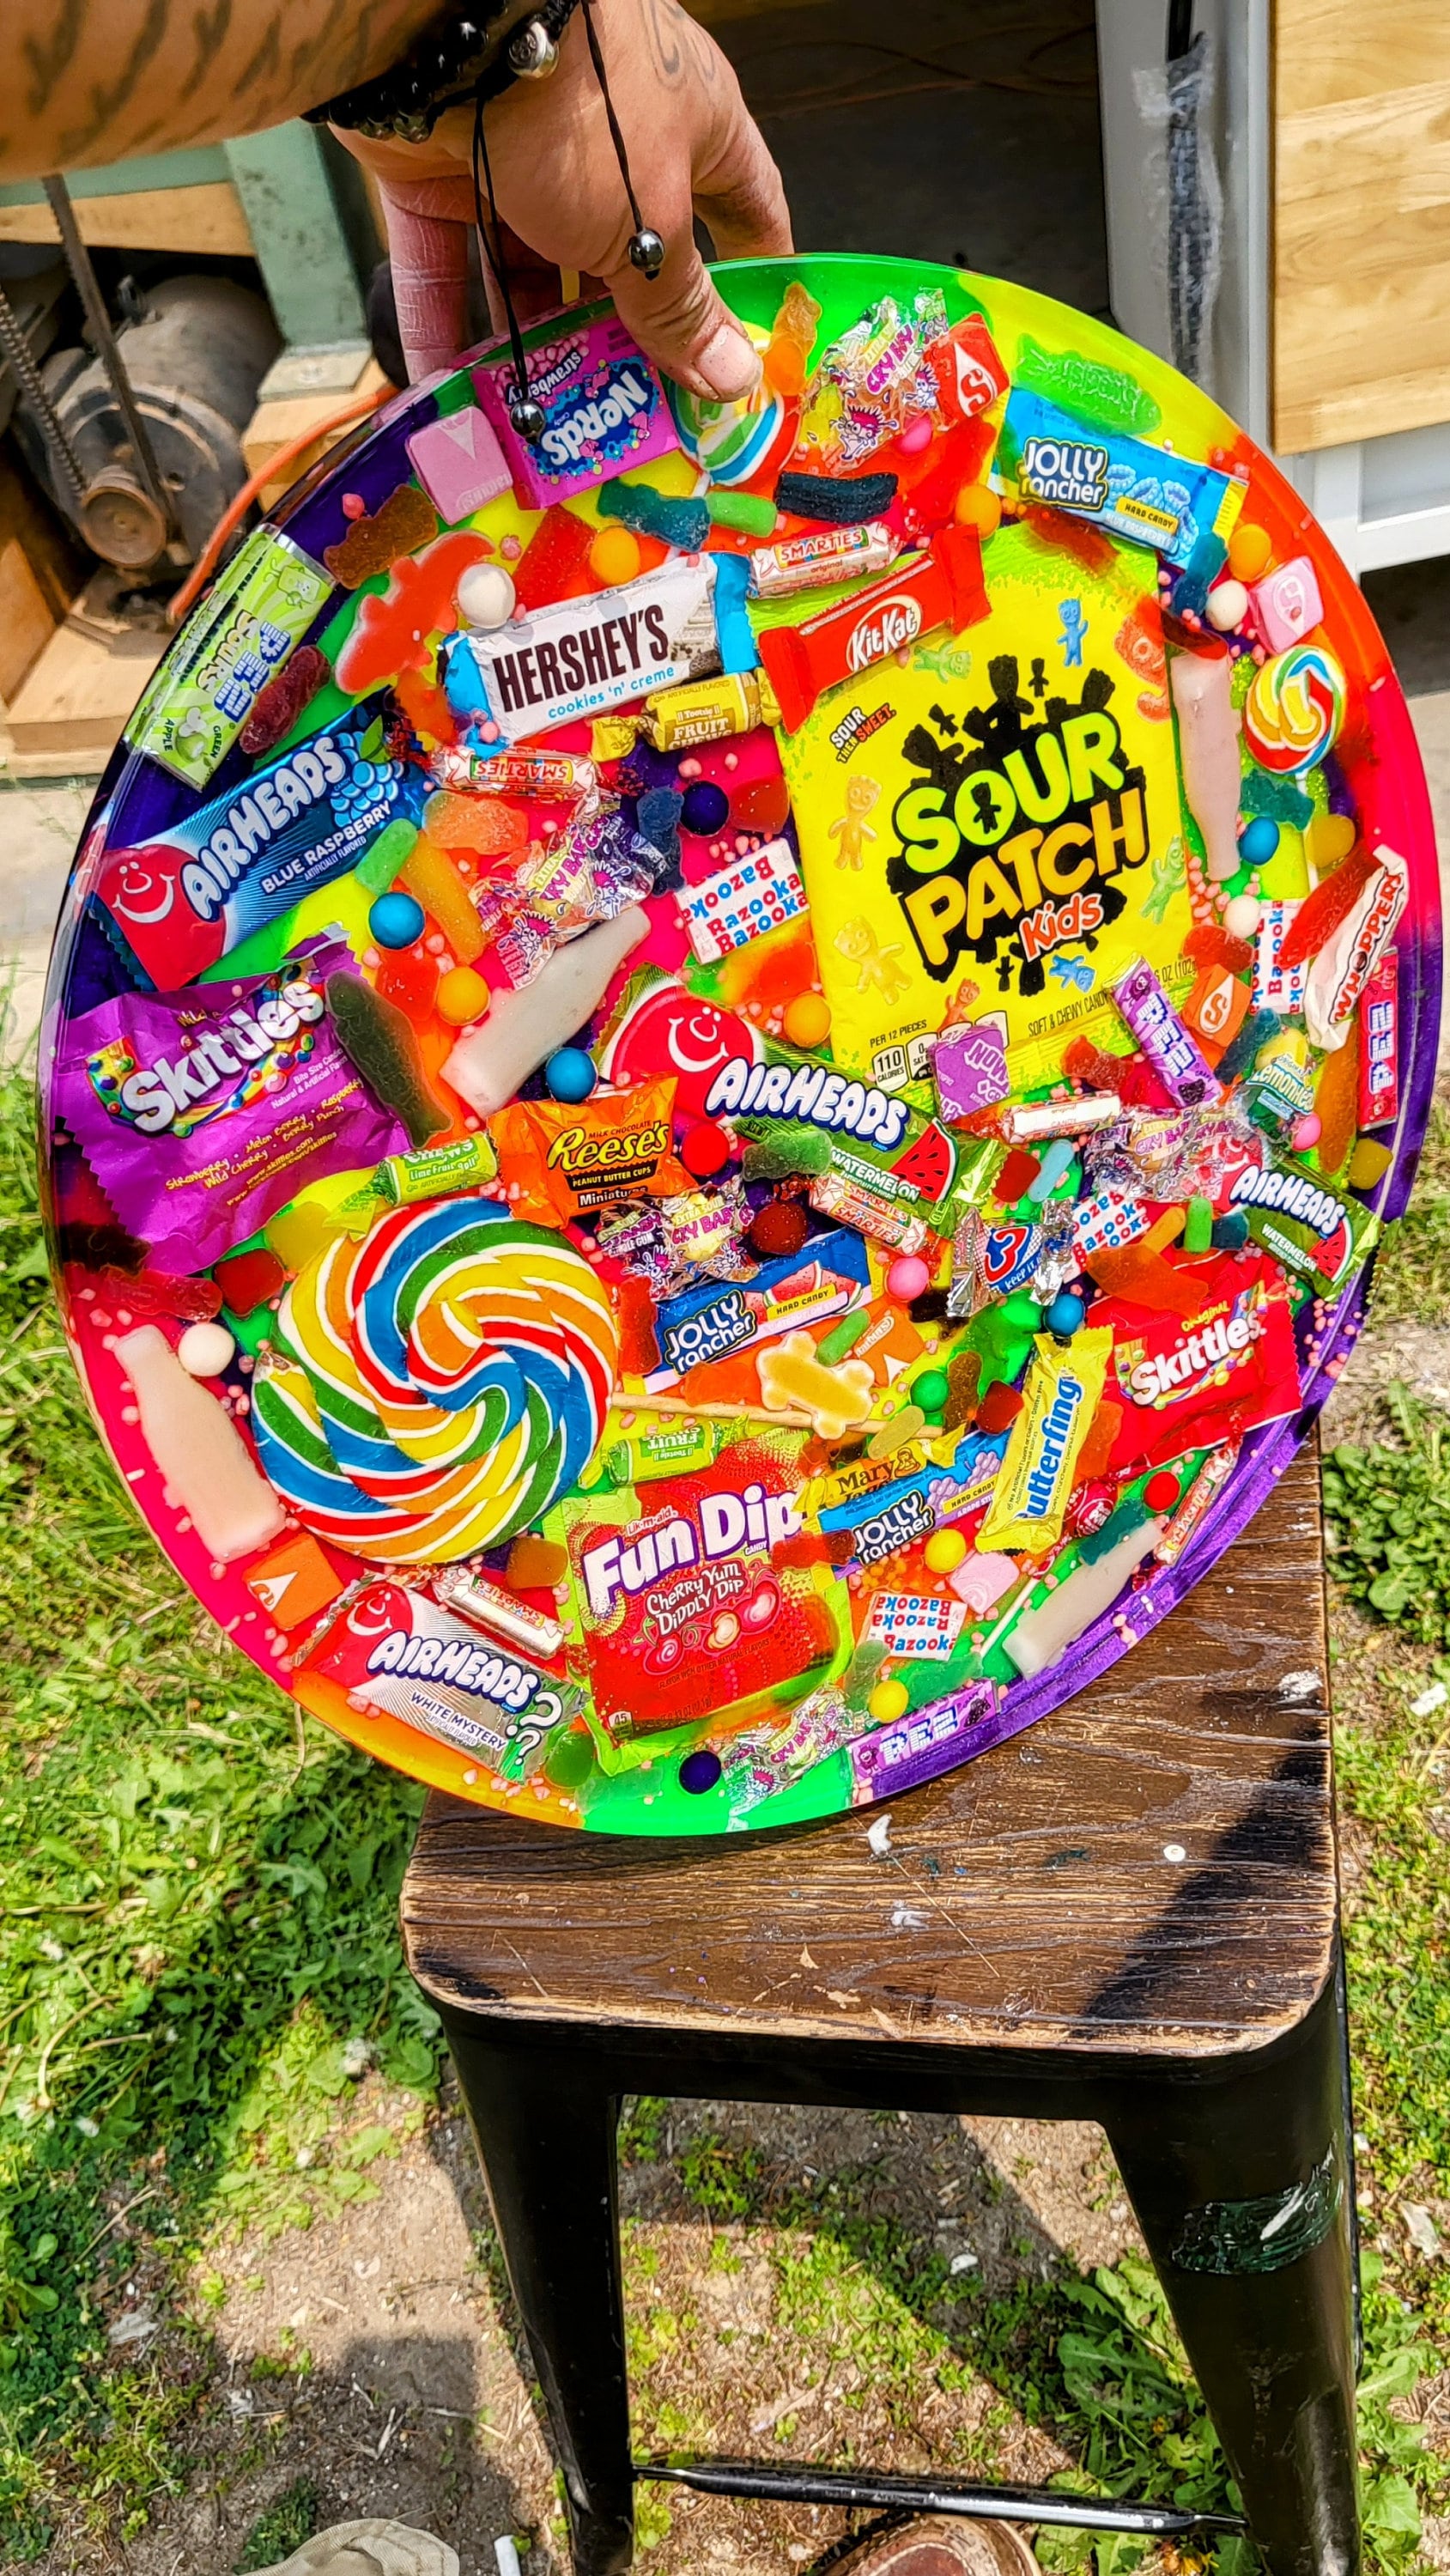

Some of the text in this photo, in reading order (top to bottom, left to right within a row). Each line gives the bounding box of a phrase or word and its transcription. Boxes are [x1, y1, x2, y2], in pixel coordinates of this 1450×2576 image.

[866, 351, 895, 394] CRY
[1026, 441, 1104, 483] JOLLY
[1021, 476, 1104, 505] rancher
[1124, 502, 1174, 529] HARD CANDY
[780, 529, 862, 560] SMARTIES
[810, 561, 843, 573] original
[197, 609, 258, 693] SOURS
[492, 605, 669, 713] HERSHEY'S
[215, 621, 291, 724] PEZ
[548, 694, 605, 720] cookies
[630, 666, 675, 691] creme
[673, 718, 729, 740] FRUIT
[684, 708, 713, 718] Tootsie
[830, 707, 866, 750] SOUR
[836, 702, 897, 763] THEN SWEET.
[163, 720, 175, 752] APPLE
[210, 726, 221, 759] GREEN
[476, 760, 568, 780] SMARTIES
[895, 712, 1126, 874] SOUR
[181, 737, 347, 920] AIRHEADS
[261, 800, 391, 894] BLUE RASPBERRY
[304, 835, 367, 882] ARTIFICIALLY FLAVORED
[906, 788, 1147, 966] PATCH
[683, 855, 774, 926] Bazooka
[716, 891, 809, 957] Bazooka
[1019, 893, 1105, 962] Kids
[1162, 969, 1173, 983] OZ
[870, 1019, 927, 1048] PER 12 PIECES
[1028, 1017, 1048, 1037] SOFT
[1049, 1017, 1056, 1030] &
[1057, 1005, 1083, 1024] CHEWY
[1136, 992, 1197, 1077] PEZ
[122, 981, 324, 1133] Skittles
[877, 1050, 901, 1072] 110
[1369, 1002, 1395, 1095] PEZ
[270, 1091, 298, 1110] Natural
[305, 1066, 331, 1090] Artificial
[293, 1063, 323, 1084] Bite Size
[877, 1066, 905, 1083] CALORIES
[707, 1059, 907, 1145] AIRHEADS
[547, 1121, 670, 1171] Reese's
[589, 1120, 652, 1139] MILK CHOCOLATE
[1136, 1132, 1163, 1156] CRY
[410, 1169, 432, 1181] Lime
[432, 1163, 455, 1175] Fruit
[573, 1166, 651, 1187] PEANUT BUTTER CUPS
[831, 1151, 921, 1203] WATERMELON
[849, 1184, 907, 1221] SMARTIES
[1230, 1165, 1346, 1234] AIRHEADS
[671, 1222, 699, 1244] CRY
[701, 1206, 735, 1234] BAB
[836, 1206, 900, 1243] SMARTIES
[984, 1227, 1029, 1284] 3
[1262, 1223, 1318, 1273] WATERMELON
[776, 1290, 828, 1315] HARD CANDY
[668, 1293, 740, 1358] JOLLY
[676, 1315, 753, 1374] rancher
[1132, 1309, 1261, 1406] Skittles
[646, 1431, 698, 1450] FRUIT
[659, 1449, 686, 1459] Tootsie
[838, 1461, 895, 1495] Mary
[951, 1481, 995, 1509] HARD CANDY
[854, 1494, 919, 1554] JOLLY
[862, 1511, 930, 1564] rancher
[585, 1519, 695, 1616] Fun
[699, 1485, 801, 1559] Dip
[744, 1542, 767, 1556] CANDY
[702, 1563, 742, 1585] Yum
[715, 1578, 744, 1599] Dip
[477, 1580, 540, 1620] SMARTIES
[876, 1596, 952, 1616] Bazooka
[871, 1614, 949, 1631] Bazooka
[368, 1632, 541, 1706] AIRHEADS
[658, 1675, 681, 1689] FLAVOR
[696, 1661, 717, 1672] OTHER
[718, 1651, 744, 1664] NATURAL
[744, 1638, 770, 1655] FLAVORS
[410, 1692, 507, 1751] WHITE MYSTERY
[881, 1707, 959, 1765] PEZ
[770, 1740, 795, 1764] CRY
